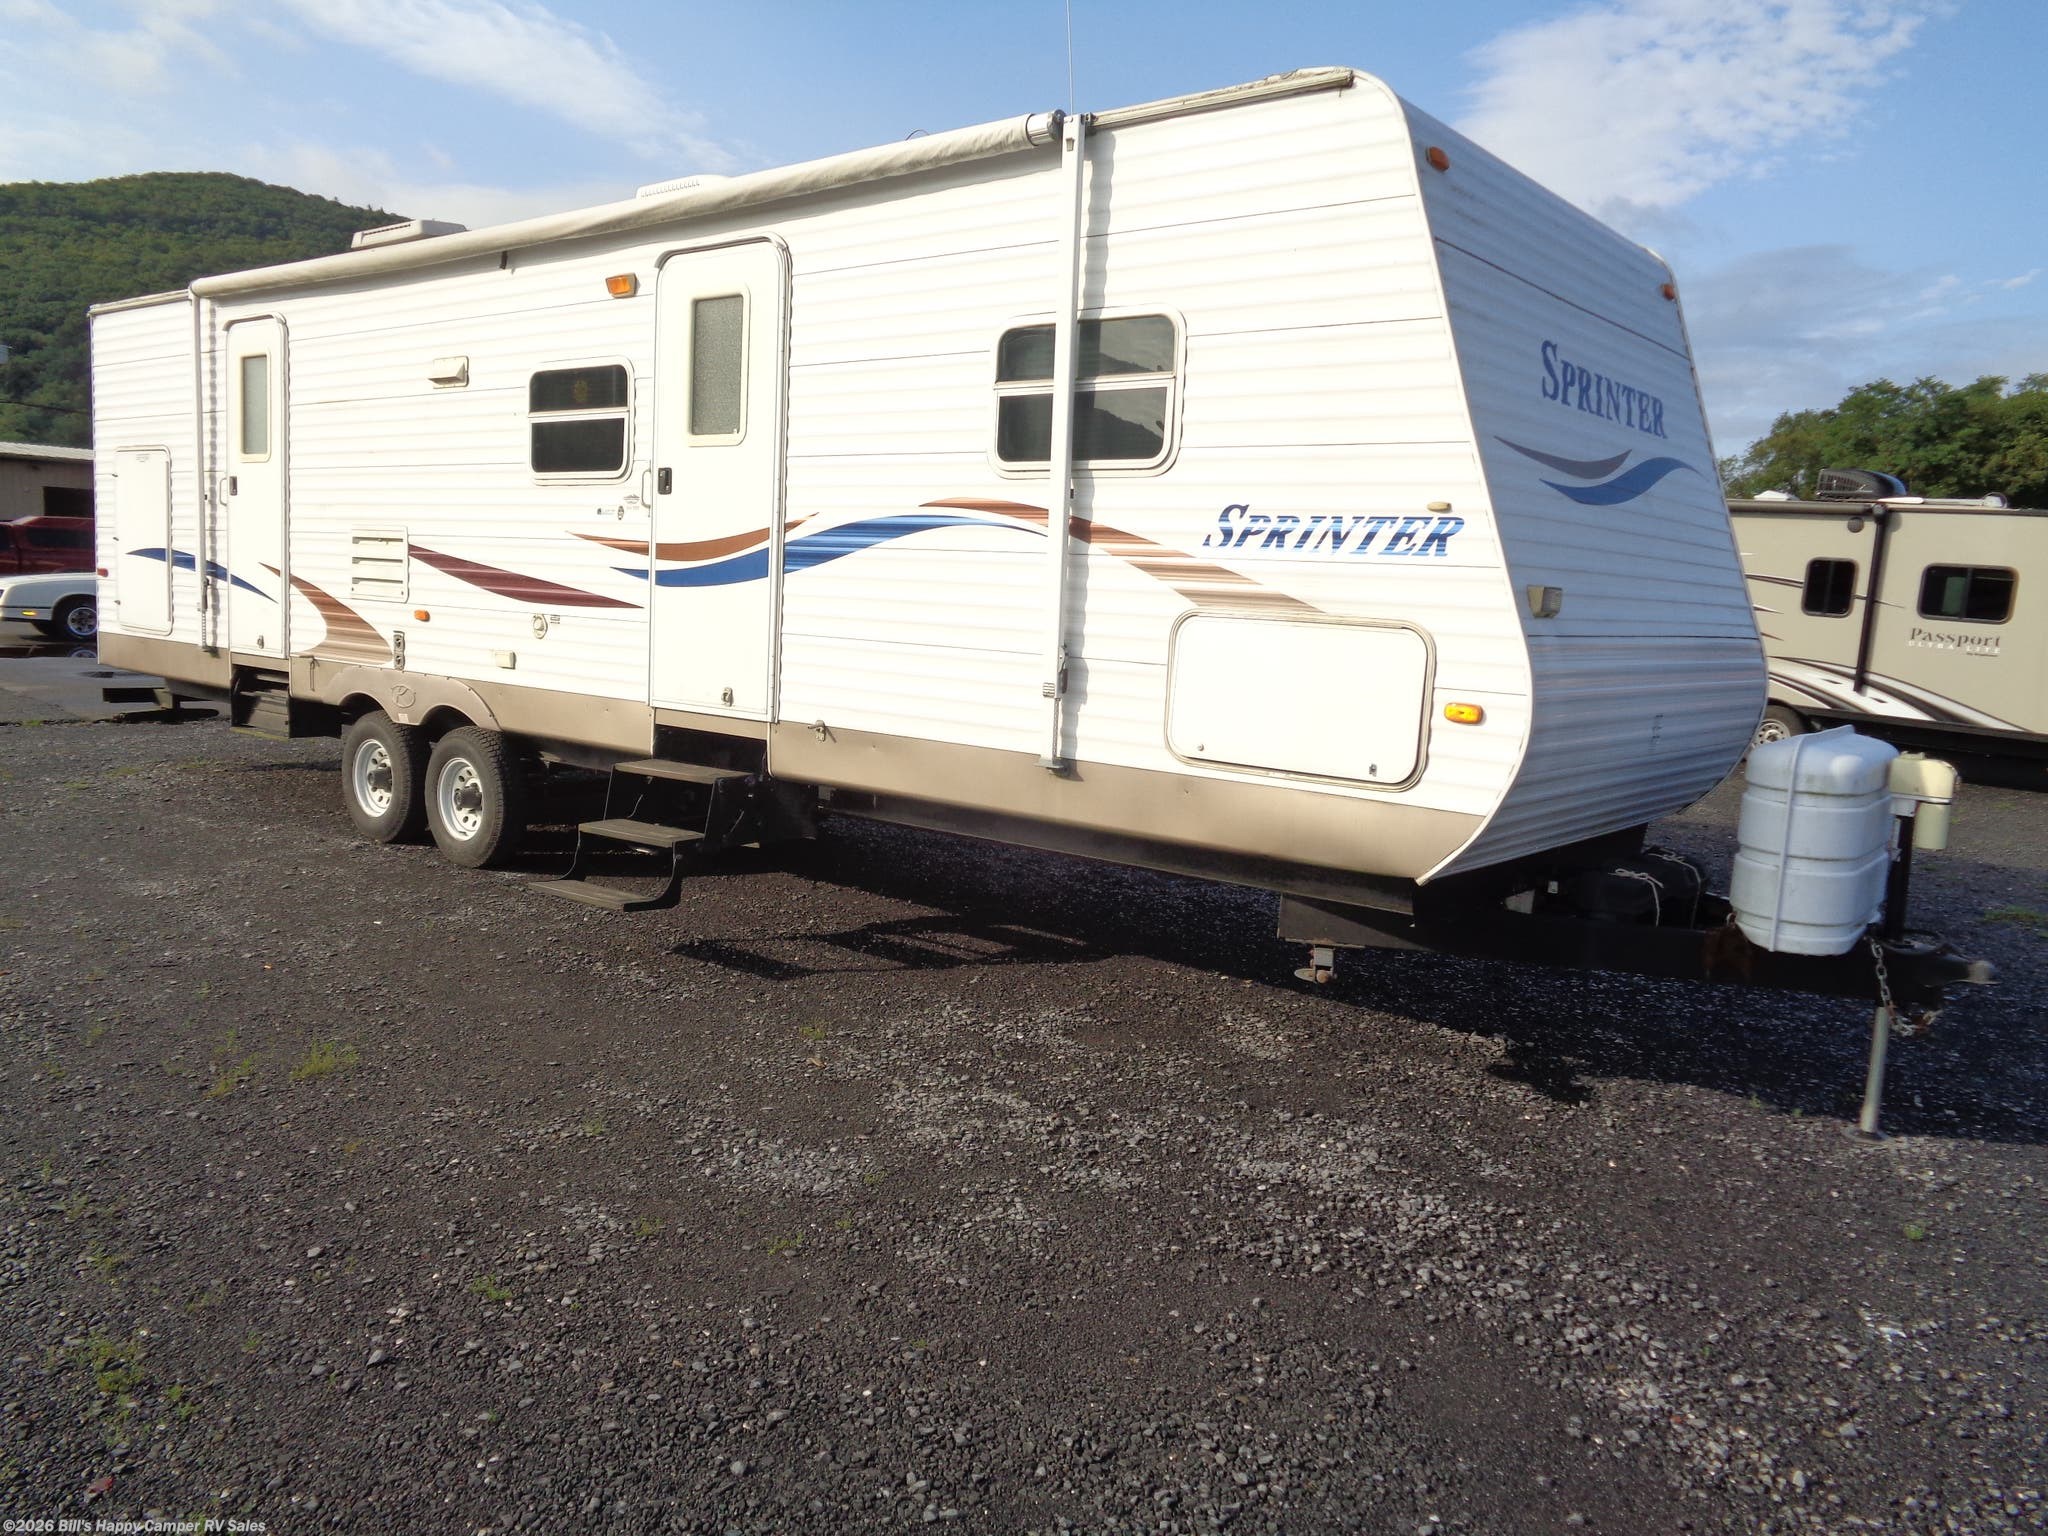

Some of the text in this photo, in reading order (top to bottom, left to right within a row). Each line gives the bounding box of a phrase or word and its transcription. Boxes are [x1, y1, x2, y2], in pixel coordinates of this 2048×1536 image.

[1541, 339, 1668, 439] SPRINTER
[1203, 503, 1465, 557] SPRINTER
[1966, 645, 2001, 654] LITE
